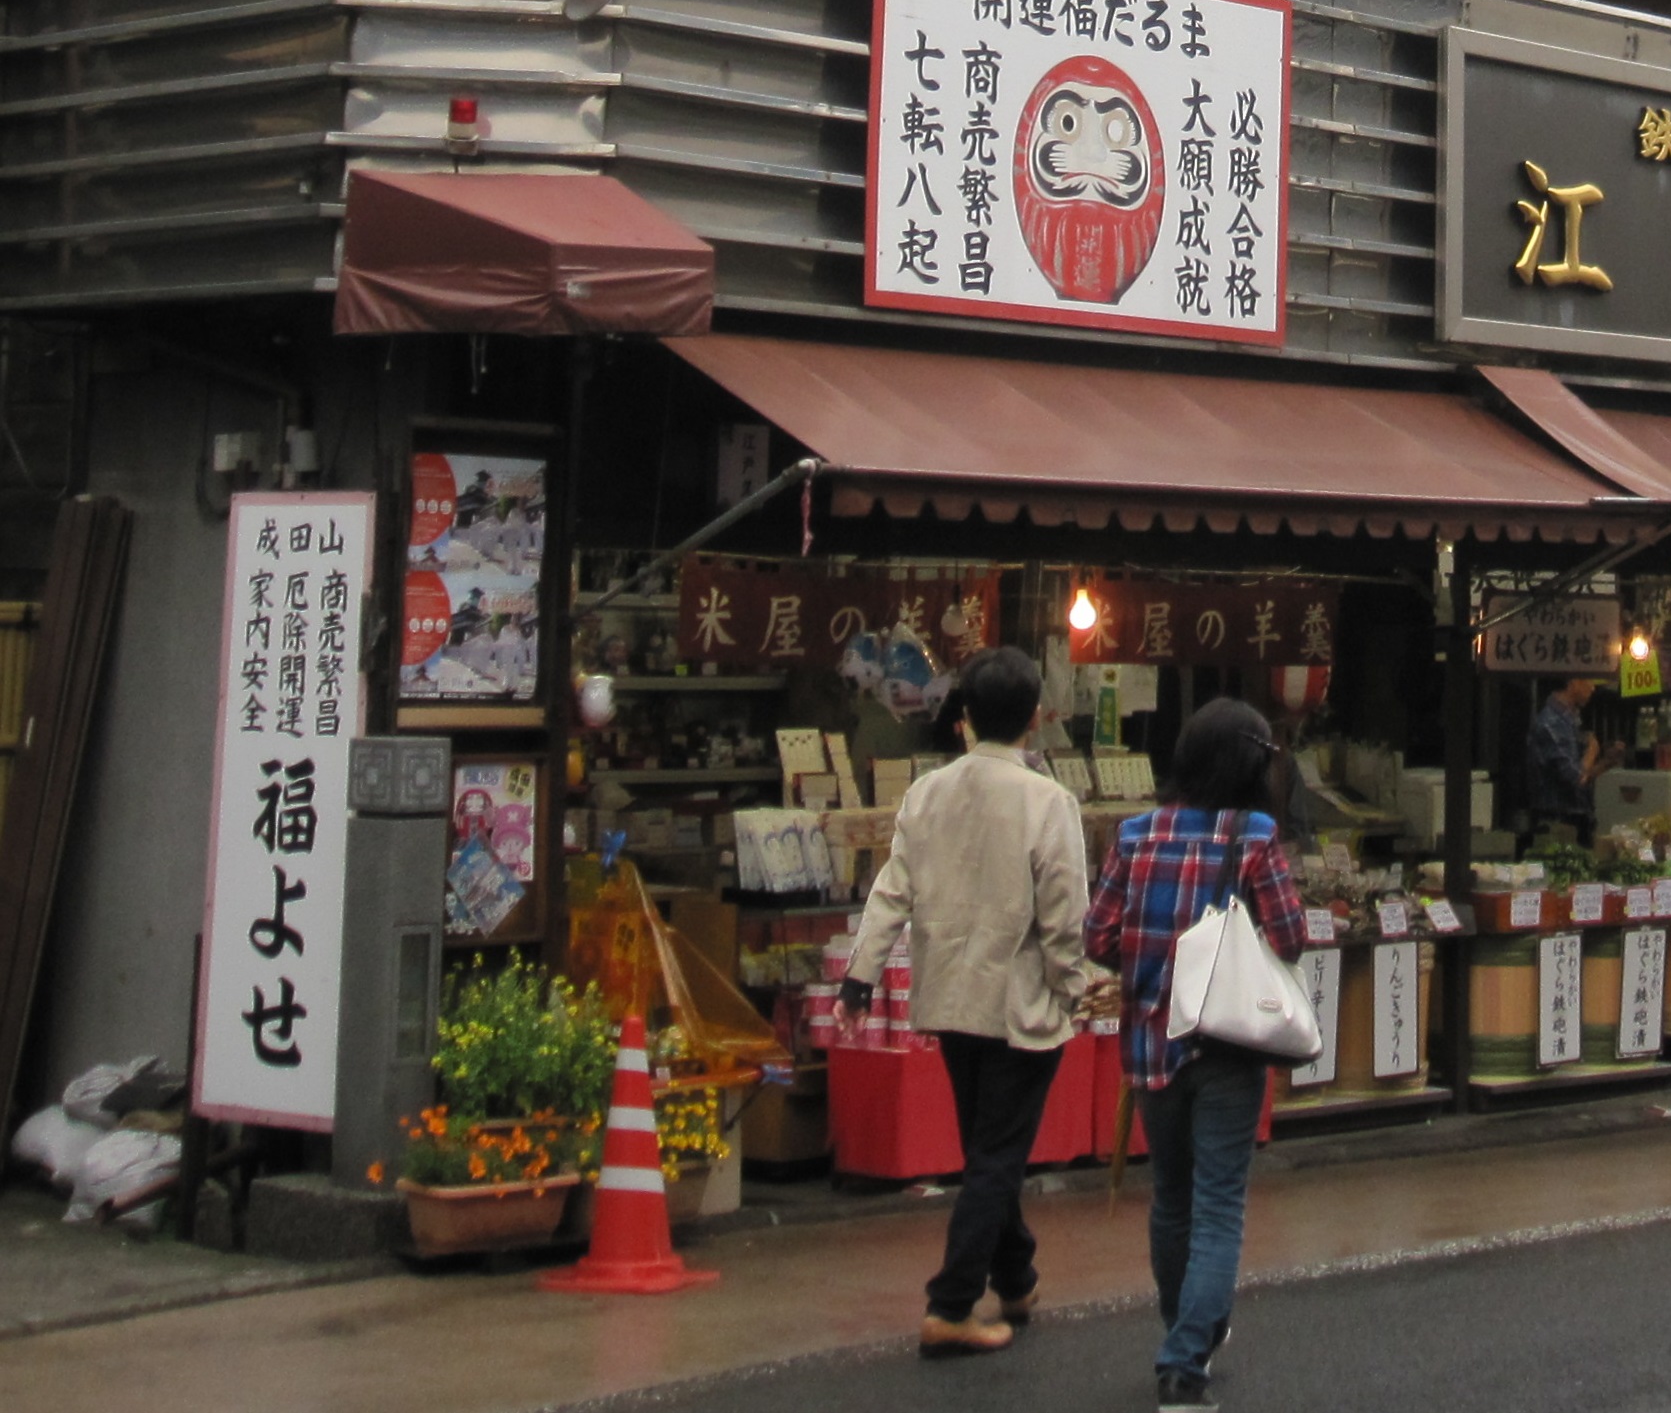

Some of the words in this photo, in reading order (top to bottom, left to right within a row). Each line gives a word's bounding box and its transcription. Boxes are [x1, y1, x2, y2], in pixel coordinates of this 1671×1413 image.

[896, 30, 945, 285] 七転八起
[957, 41, 1001, 296] 商売繁昌
[1175, 78, 1216, 316] 大願成就
[1225, 89, 1265, 319] 必勝合格
[254, 517, 345, 561] 成田山
[240, 568, 275, 735] 家内安全
[277, 570, 310, 739] 厄除開運
[315, 568, 349, 738] 商売繁昌
[241, 756, 318, 1069] 福よせ
[1631, 935, 1651, 1048] はぐら鉄砲漬
[1389, 947, 1405, 1069] りんごきゅうり
[1552, 941, 1568, 1057] はぐら鉄砲漬
